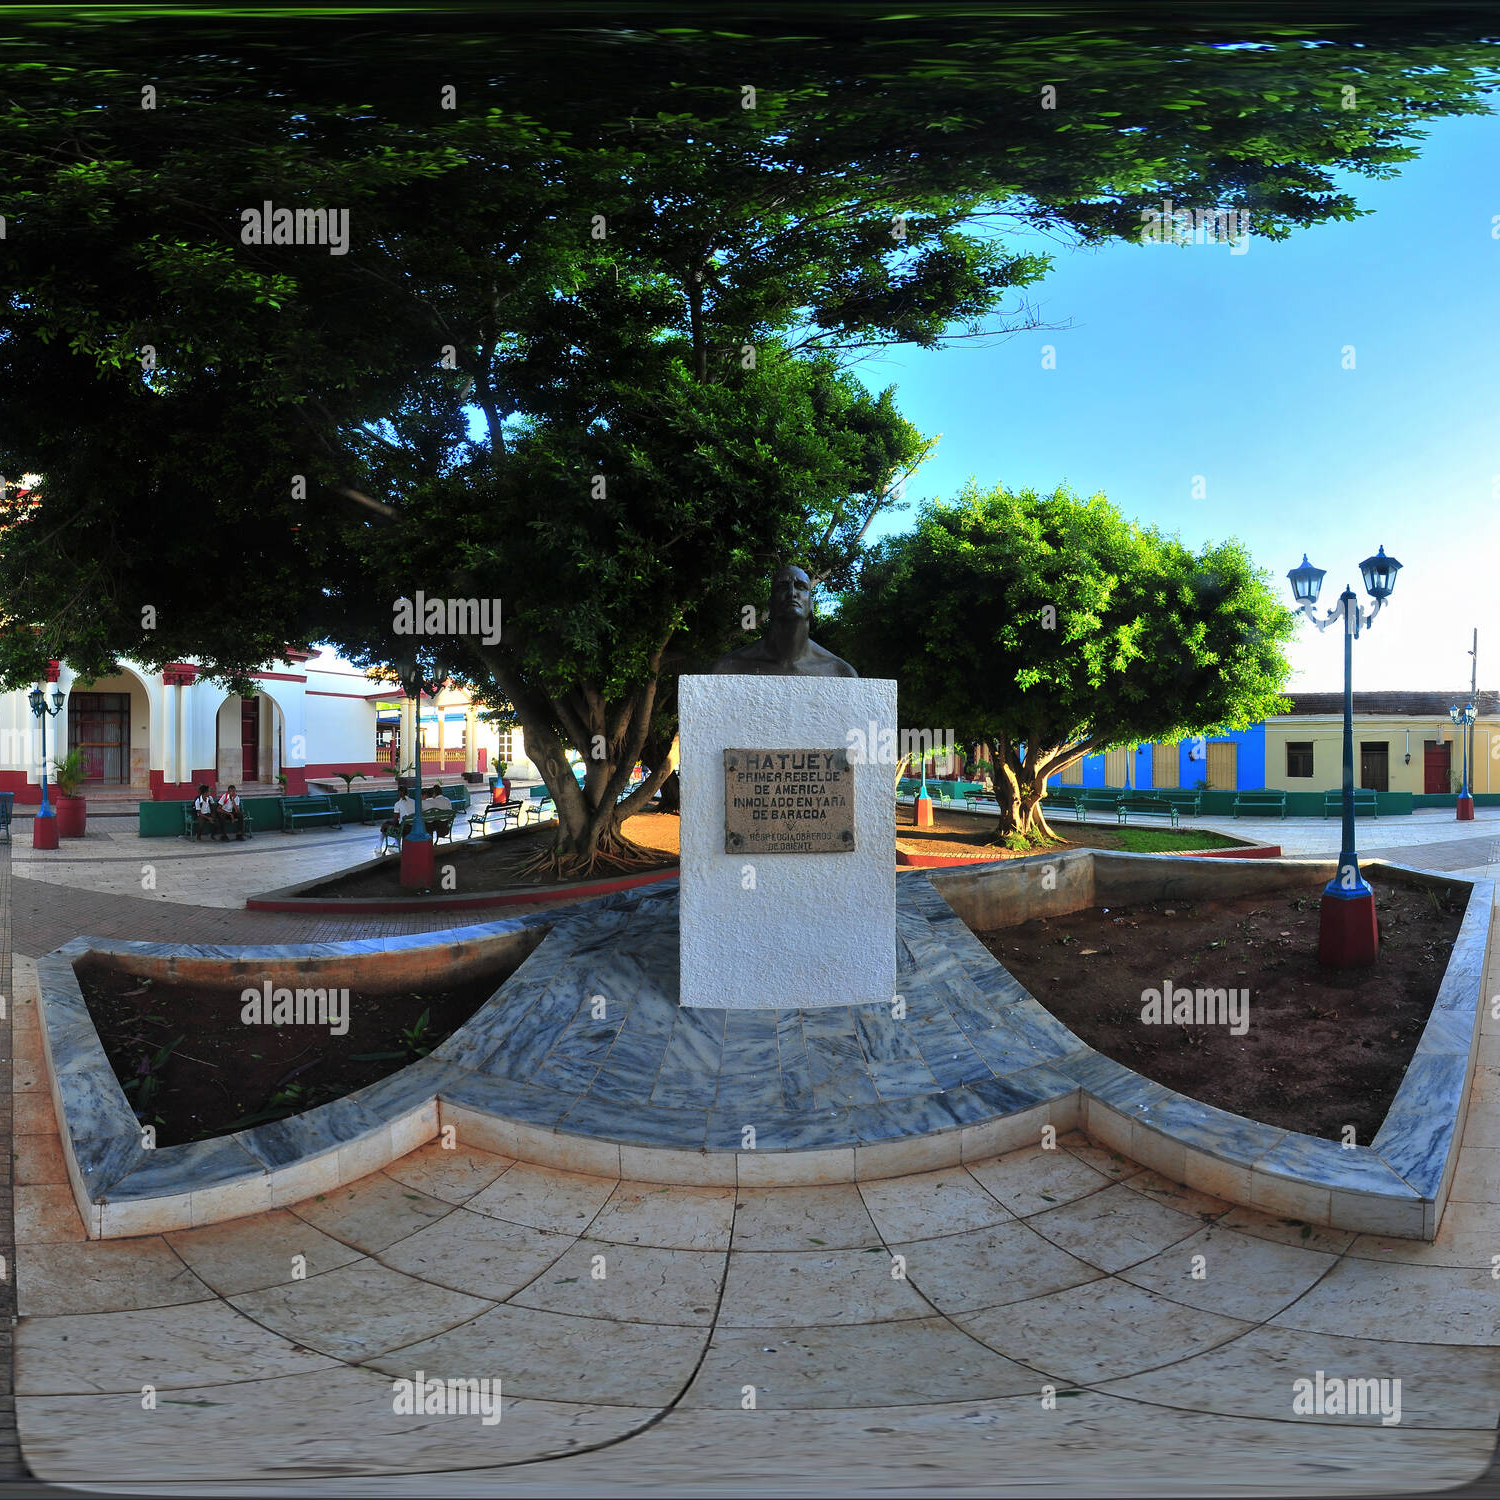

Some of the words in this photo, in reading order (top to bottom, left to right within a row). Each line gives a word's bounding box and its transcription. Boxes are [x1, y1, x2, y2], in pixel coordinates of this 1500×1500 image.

[746, 753, 834, 770] HATUEY
[738, 772, 782, 782] PRIMER
[784, 771, 840, 782] REBELDE
[754, 784, 770, 795] DE
[775, 783, 826, 795] AMERICA
[796, 797, 812, 808] EN
[816, 796, 846, 808] YARA
[753, 809, 768, 820] DE
[771, 809, 827, 820] BARACOA
